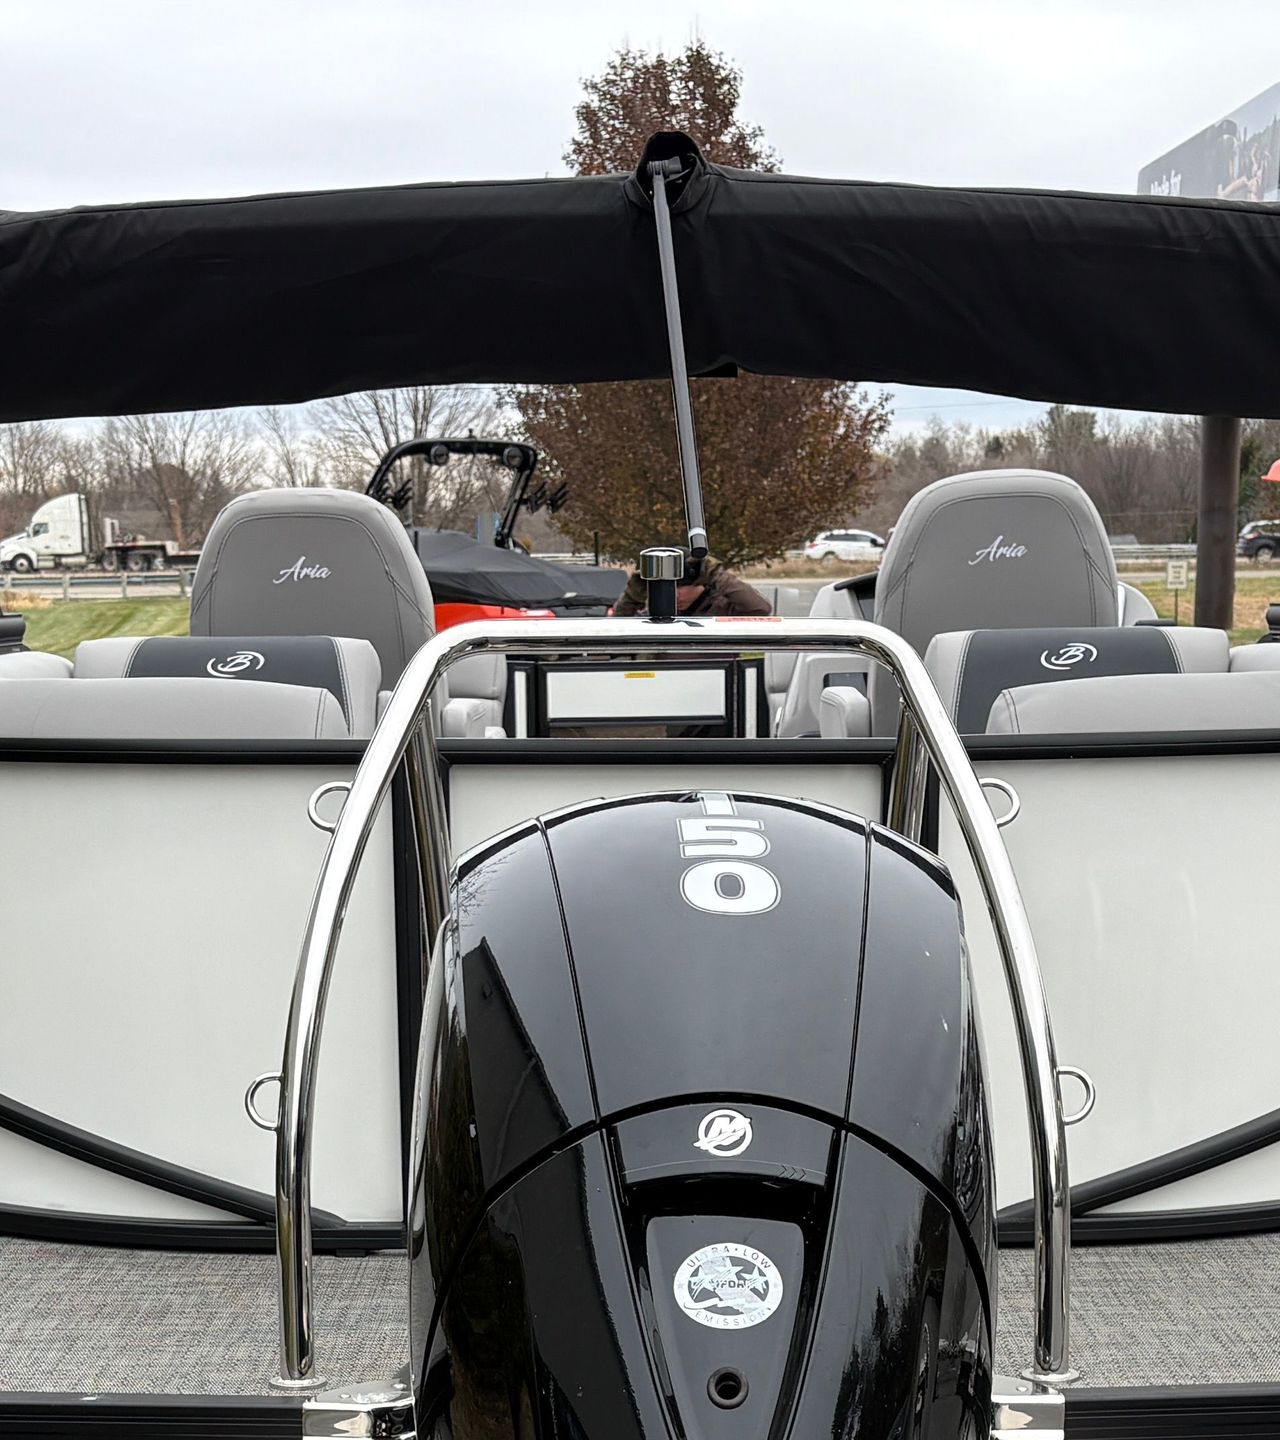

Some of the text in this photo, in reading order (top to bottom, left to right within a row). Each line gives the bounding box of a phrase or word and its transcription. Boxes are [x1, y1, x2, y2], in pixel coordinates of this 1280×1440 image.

[968, 535, 1028, 565] Aria
[273, 556, 332, 584] Aria
[743, 1248, 772, 1269] LOW
